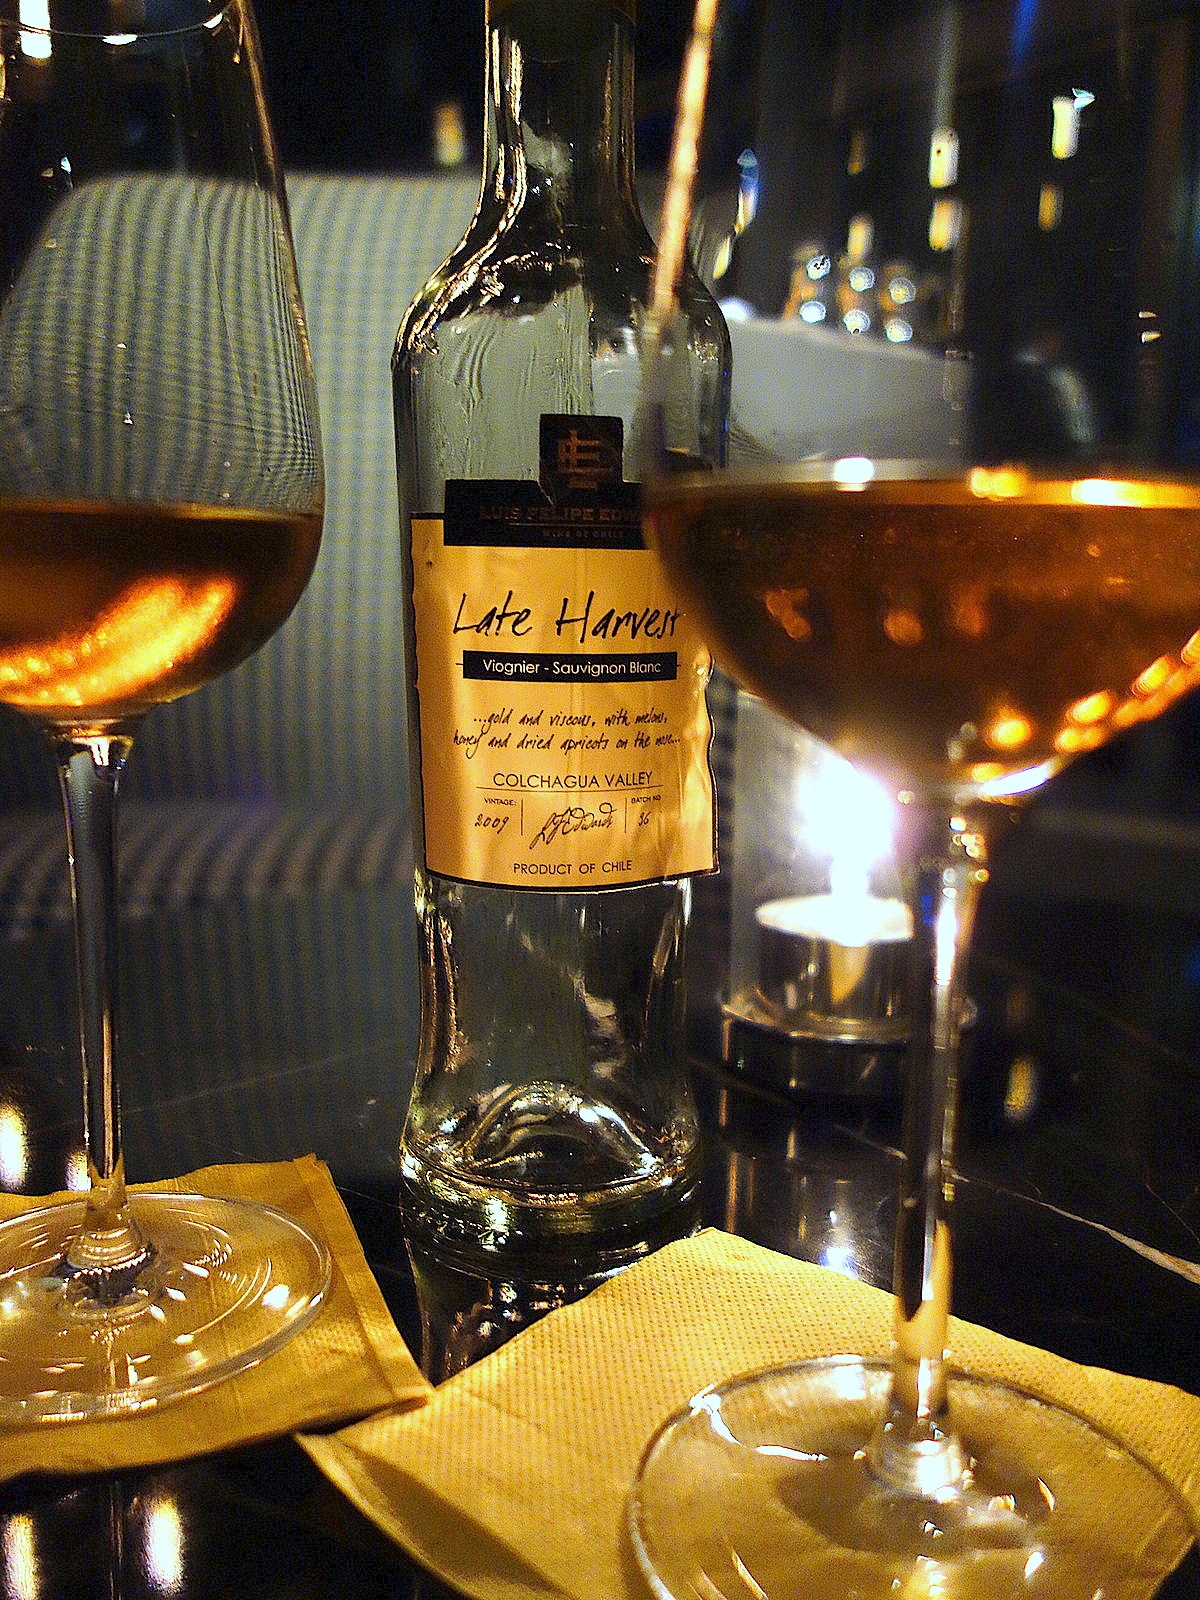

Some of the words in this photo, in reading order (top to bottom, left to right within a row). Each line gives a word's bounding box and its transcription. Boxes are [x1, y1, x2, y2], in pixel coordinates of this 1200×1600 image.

[453, 590, 533, 637] Late
[556, 590, 679, 643] Harvest
[483, 658, 541, 675] Viognier
[552, 660, 627, 677] Sauvignon
[629, 661, 662, 674] Blanc
[518, 709, 544, 727] and
[605, 708, 630, 727] with
[453, 730, 483, 760] honey
[488, 733, 508, 748] and
[516, 733, 553, 750] dried
[560, 733, 610, 756] apricots
[615, 738, 629, 749] on
[634, 731, 651, 748] the
[493, 772, 600, 789] COLCHAGUA
[605, 771, 653, 788] VALLEY
[474, 813, 510, 835] 2009
[513, 862, 575, 875] PRODUCT
[579, 863, 597, 874] OF
[602, 860, 633, 873] CHILE
